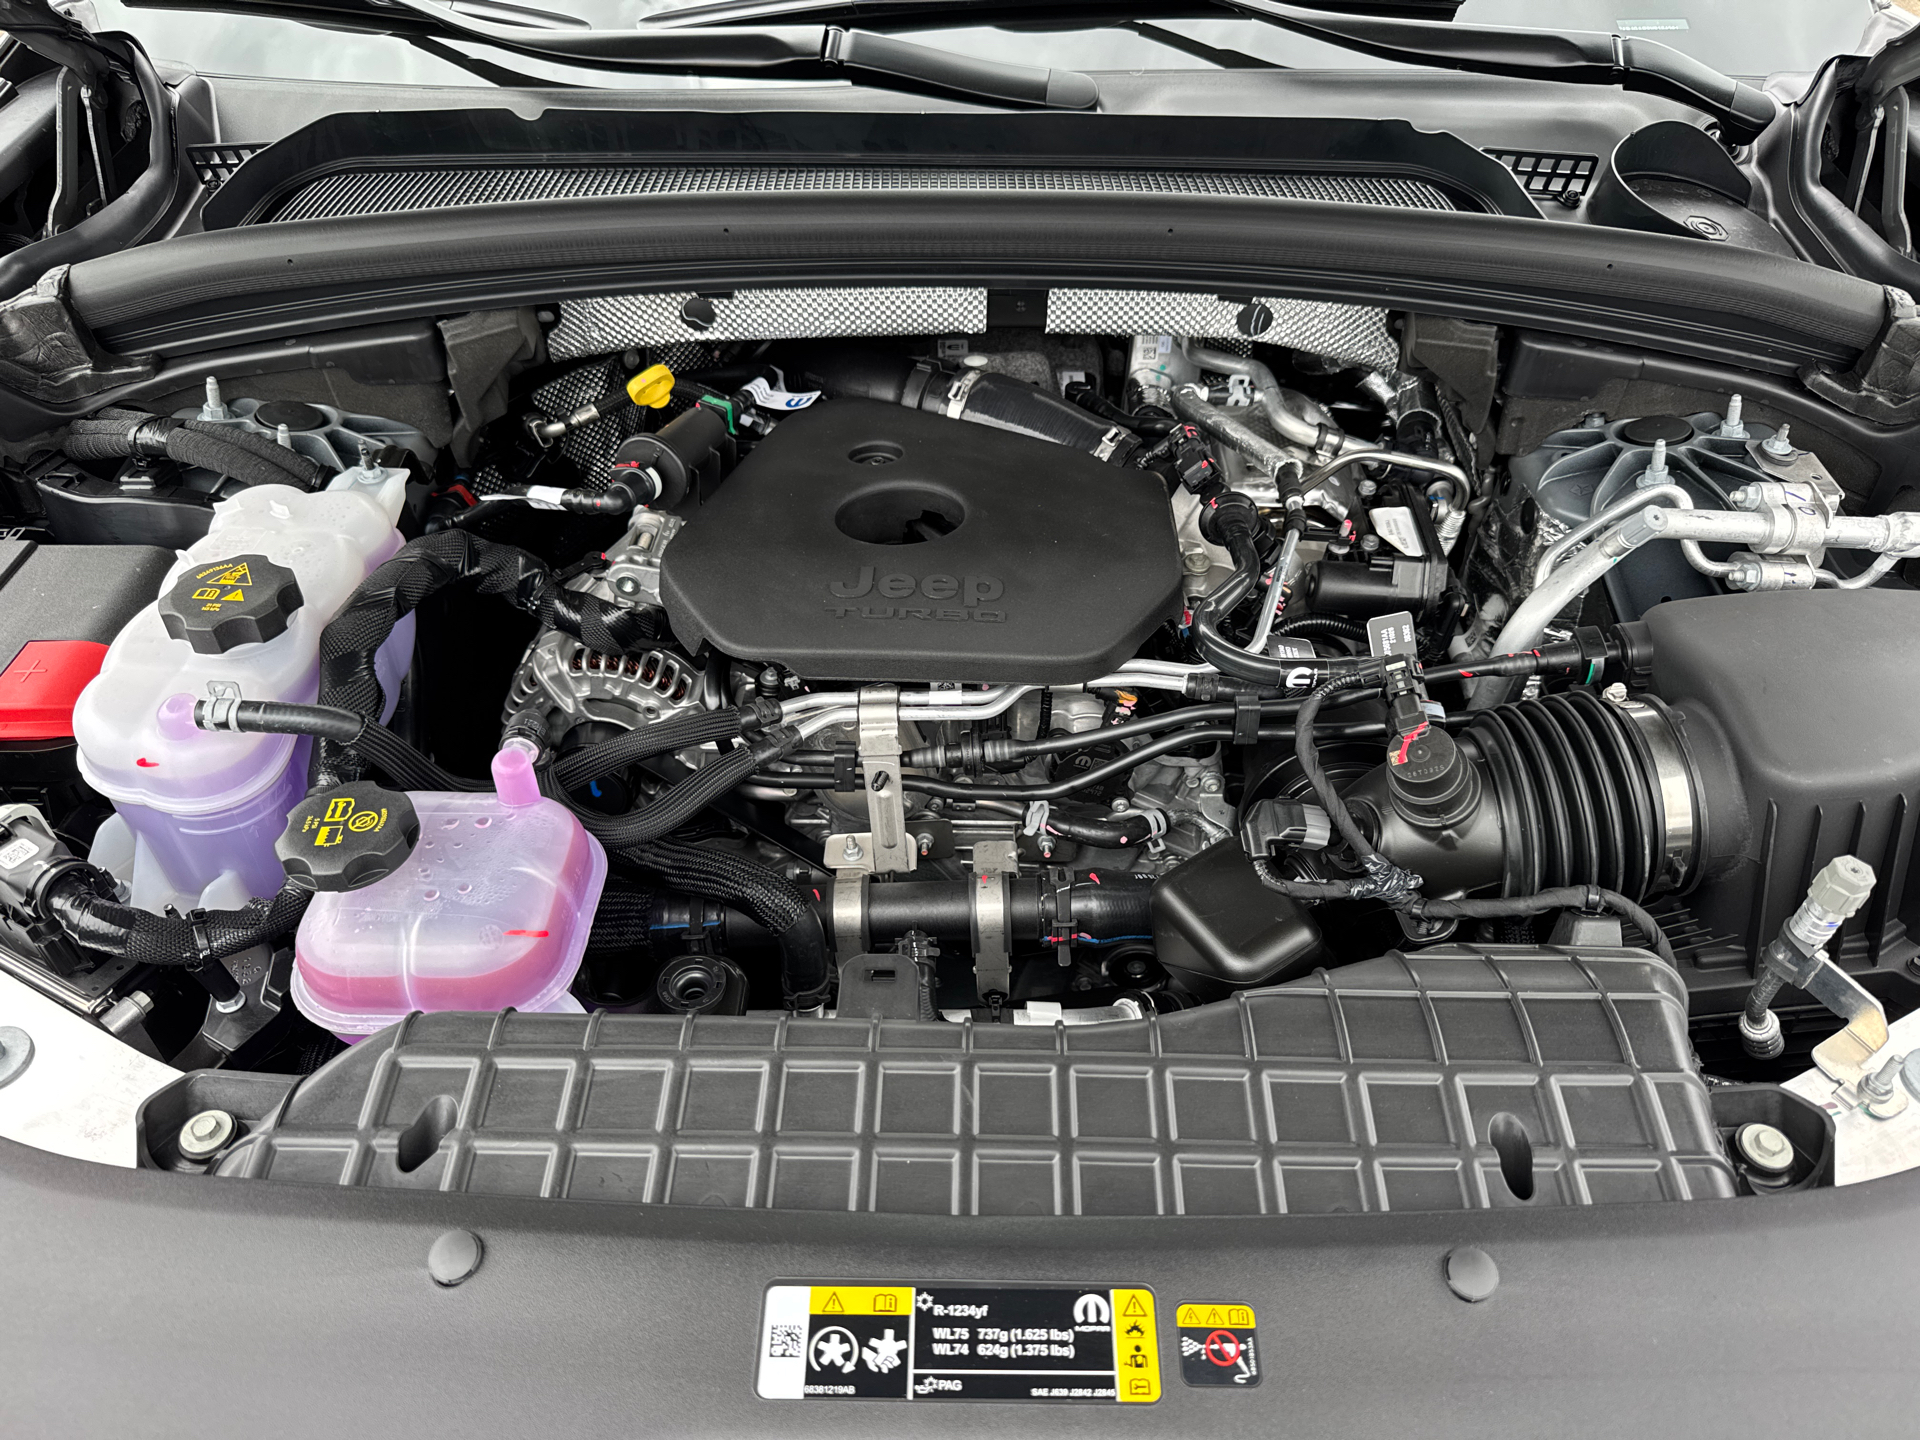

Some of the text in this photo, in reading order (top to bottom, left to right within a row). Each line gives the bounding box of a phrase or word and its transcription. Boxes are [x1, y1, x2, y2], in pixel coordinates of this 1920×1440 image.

[830, 566, 1005, 608] Jeep
[825, 607, 1007, 623] TURBO
[932, 1304, 989, 1319] R-1234yf
[932, 1327, 1075, 1343] WL75 737g (1.625 lbs)
[932, 1343, 1076, 1359] WL74 624g (1.375 lbs)
[938, 1379, 963, 1392] PAG
[1030, 1387, 1116, 1398] SAE J639 J2842 J2845
